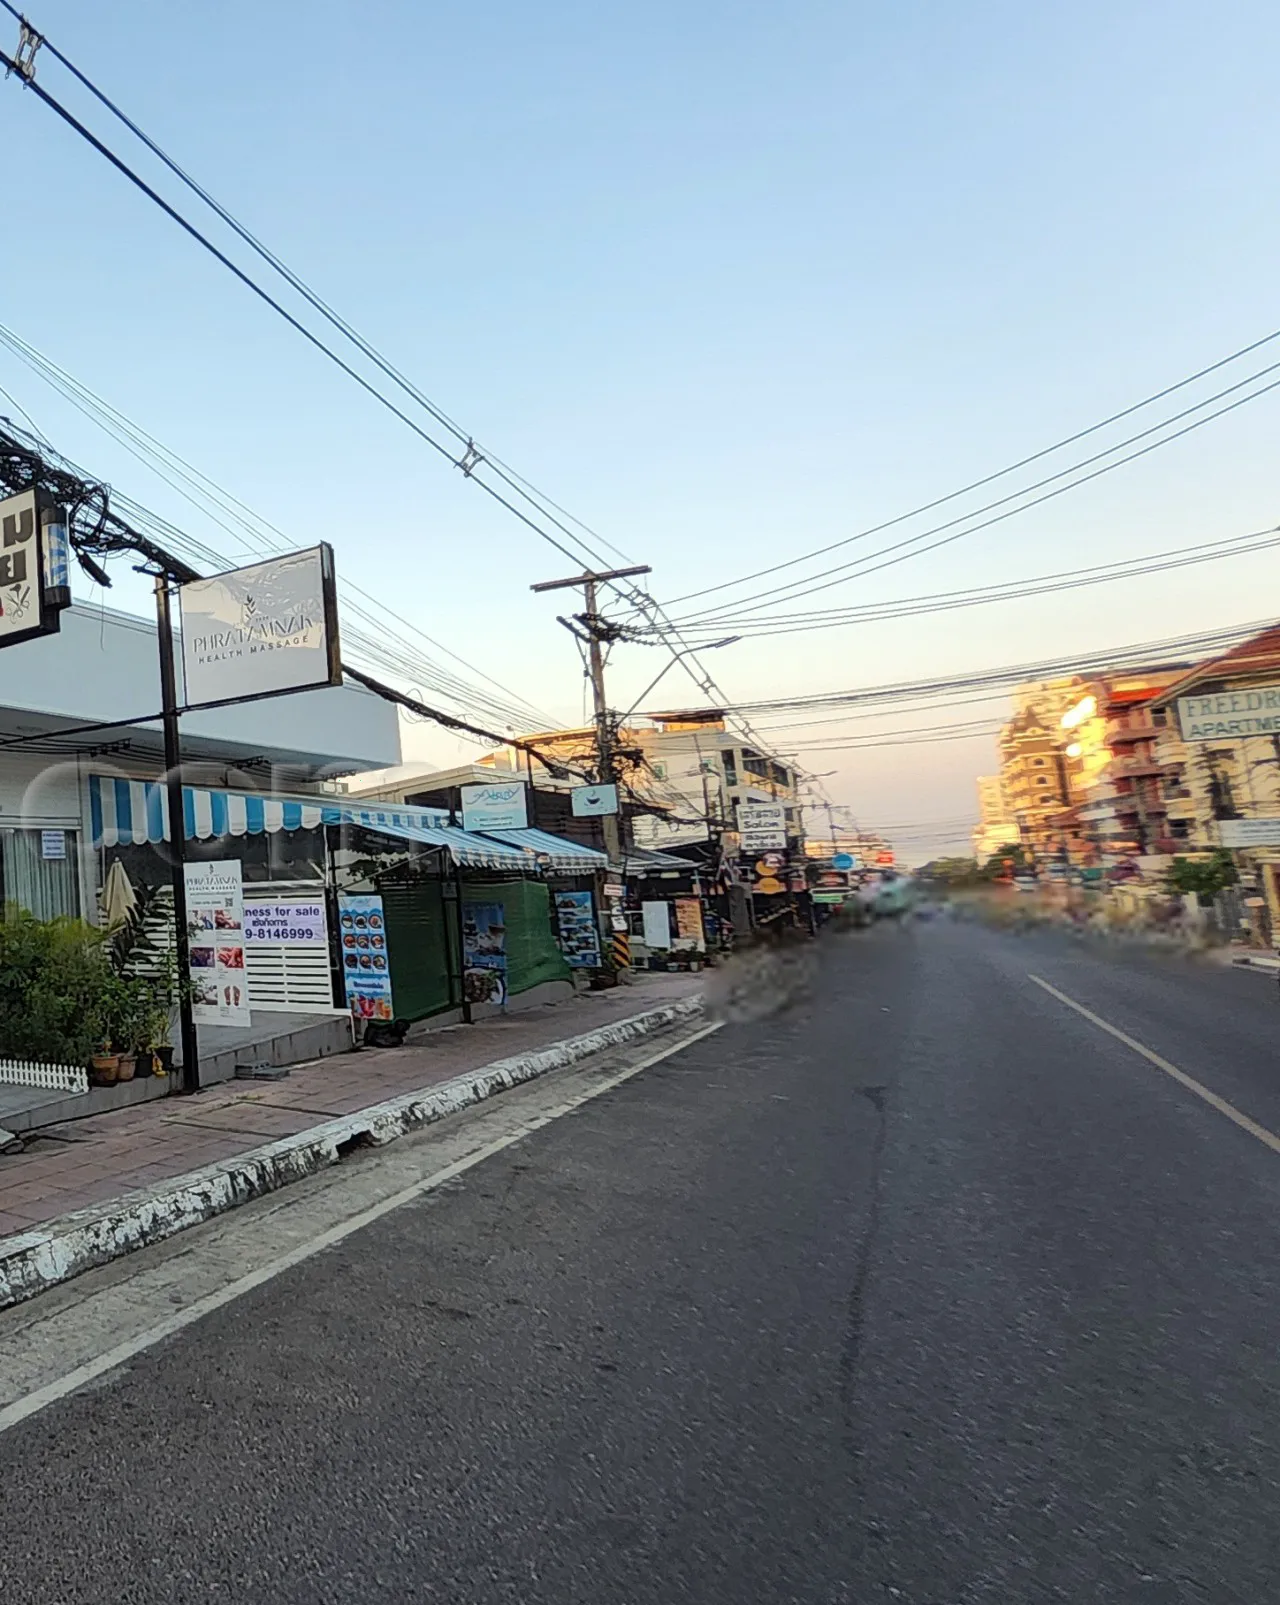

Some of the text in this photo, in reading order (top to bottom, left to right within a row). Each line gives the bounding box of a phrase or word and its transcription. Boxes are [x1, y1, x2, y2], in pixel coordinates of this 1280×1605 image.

[198, 635, 309, 665] HEALTH MASSAGE
[1186, 689, 1280, 718] FREEDR
[275, 906, 291, 916] for
[295, 906, 320, 916] sale
